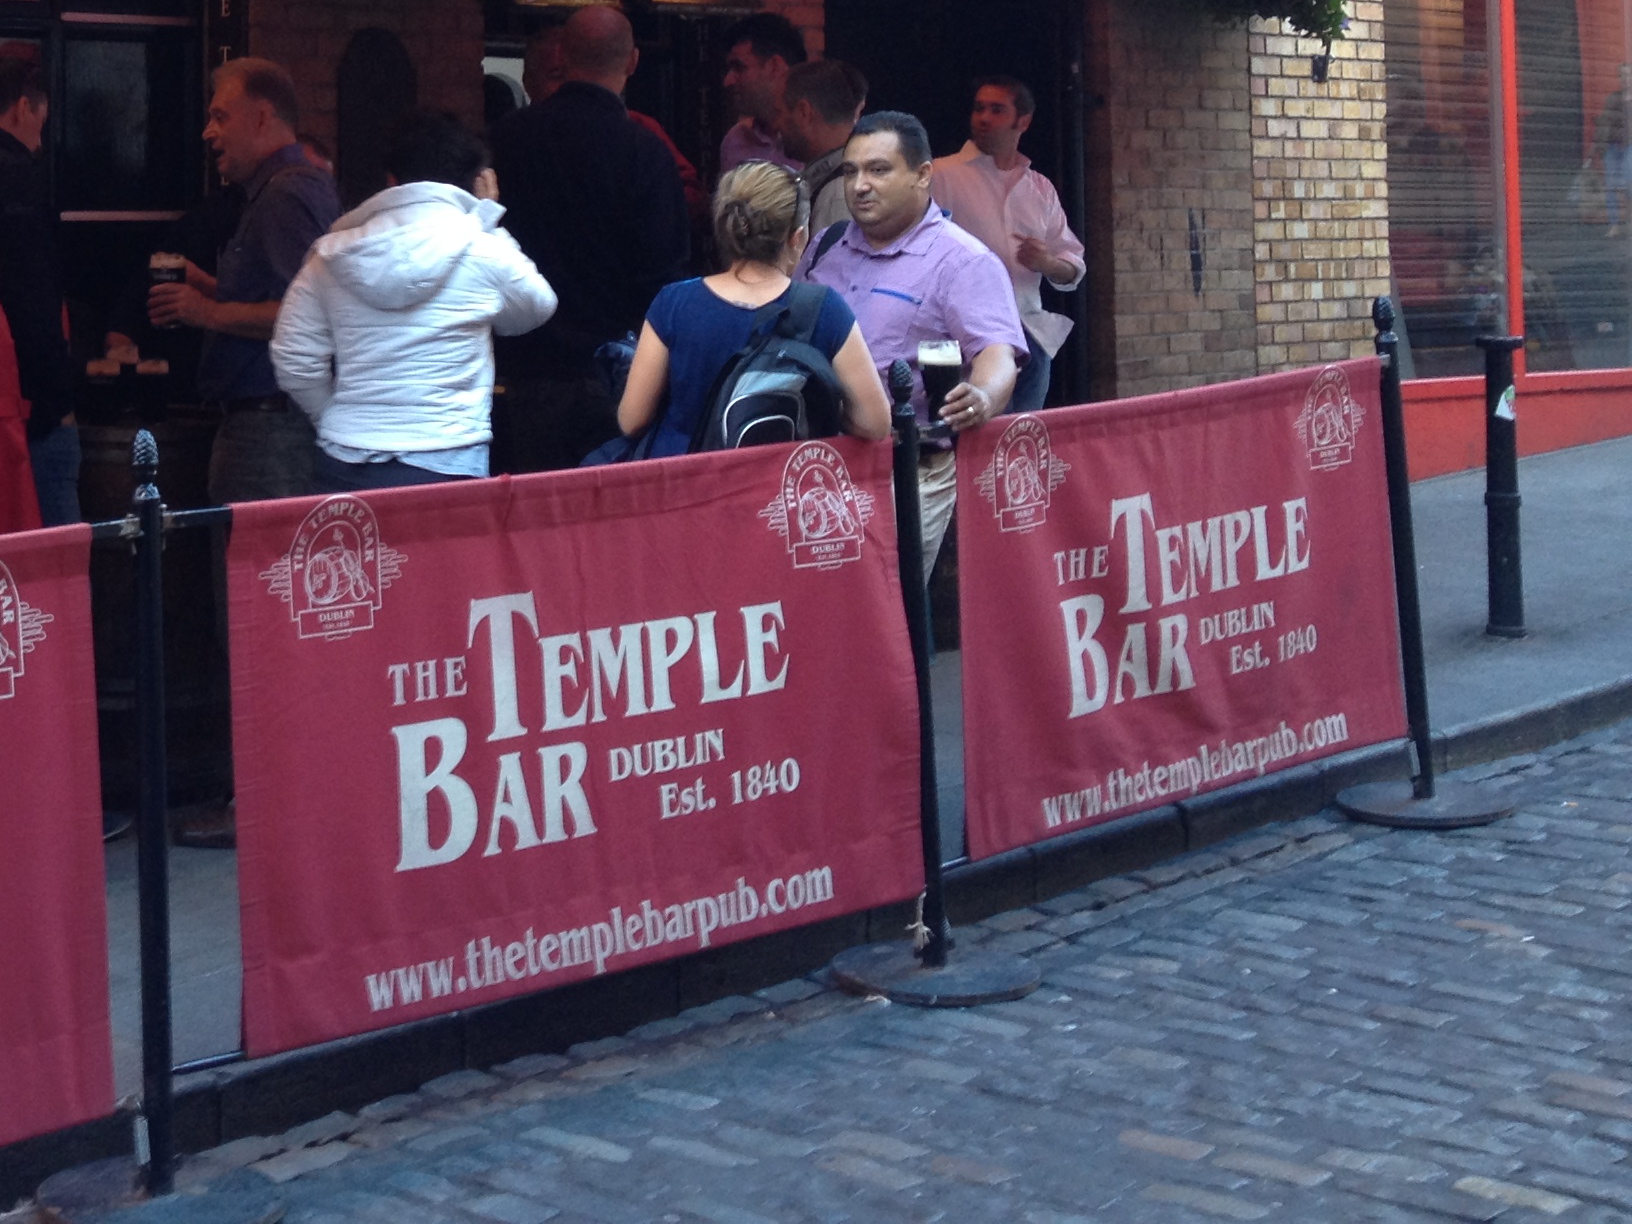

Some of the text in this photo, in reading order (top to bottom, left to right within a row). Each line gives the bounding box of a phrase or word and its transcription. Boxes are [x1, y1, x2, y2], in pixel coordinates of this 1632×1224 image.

[792, 447, 836, 472] TEMPLE
[294, 501, 376, 573] THE TEMPLE BAR
[1053, 492, 1312, 615] THE TEMPLE
[387, 590, 791, 743] THE TEMPLE
[1059, 593, 1277, 719] BAR DUBLIN
[1229, 623, 1318, 675] Est. 1840
[390, 717, 726, 874] BAR DUBLIN
[659, 757, 801, 820] Est. 1840
[1041, 712, 1350, 829] www.thetemplebarpub.com
[365, 865, 835, 1013] www.thetemplebarpub.com
